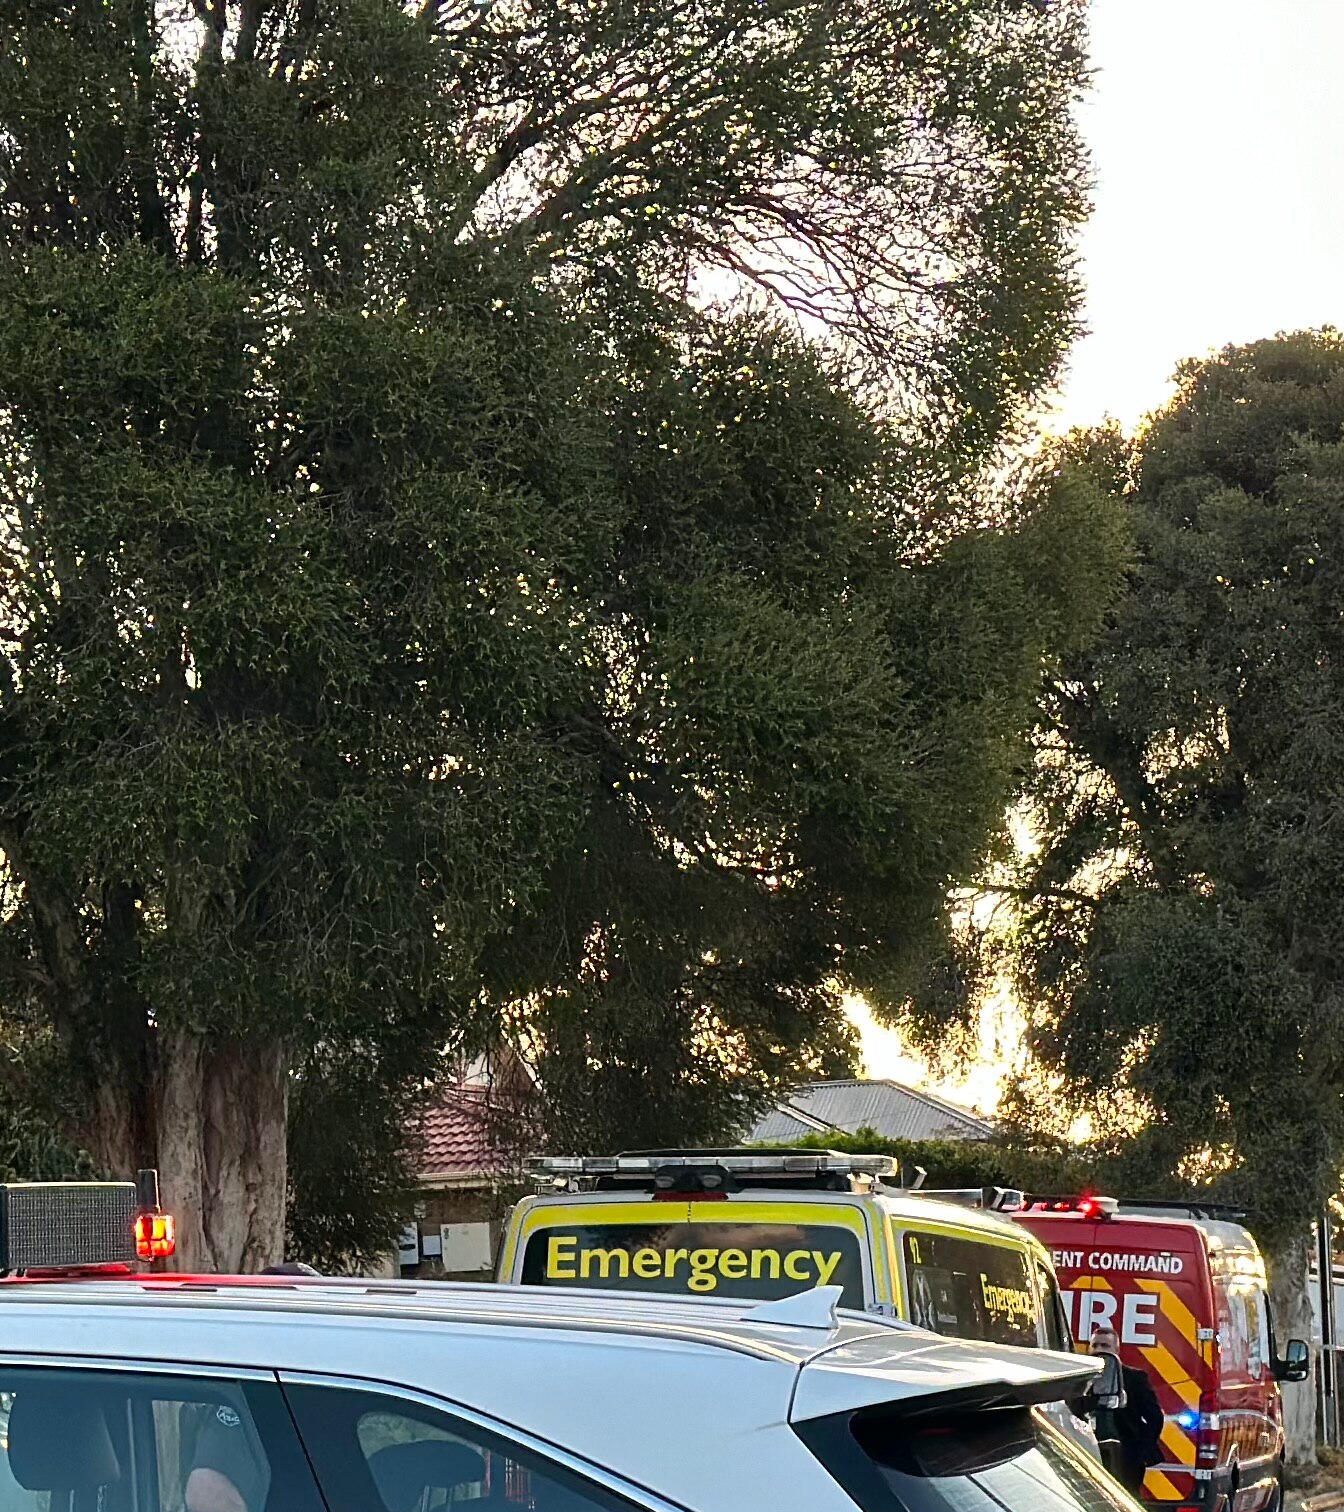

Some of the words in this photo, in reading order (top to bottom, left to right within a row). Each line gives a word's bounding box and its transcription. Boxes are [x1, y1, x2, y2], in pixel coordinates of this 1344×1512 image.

[546, 1236, 842, 1292] Emergency
[1052, 1251, 1084, 1268] ENT
[1088, 1252, 1183, 1274] COMMAND
[1059, 1290, 1158, 1346] IRE
